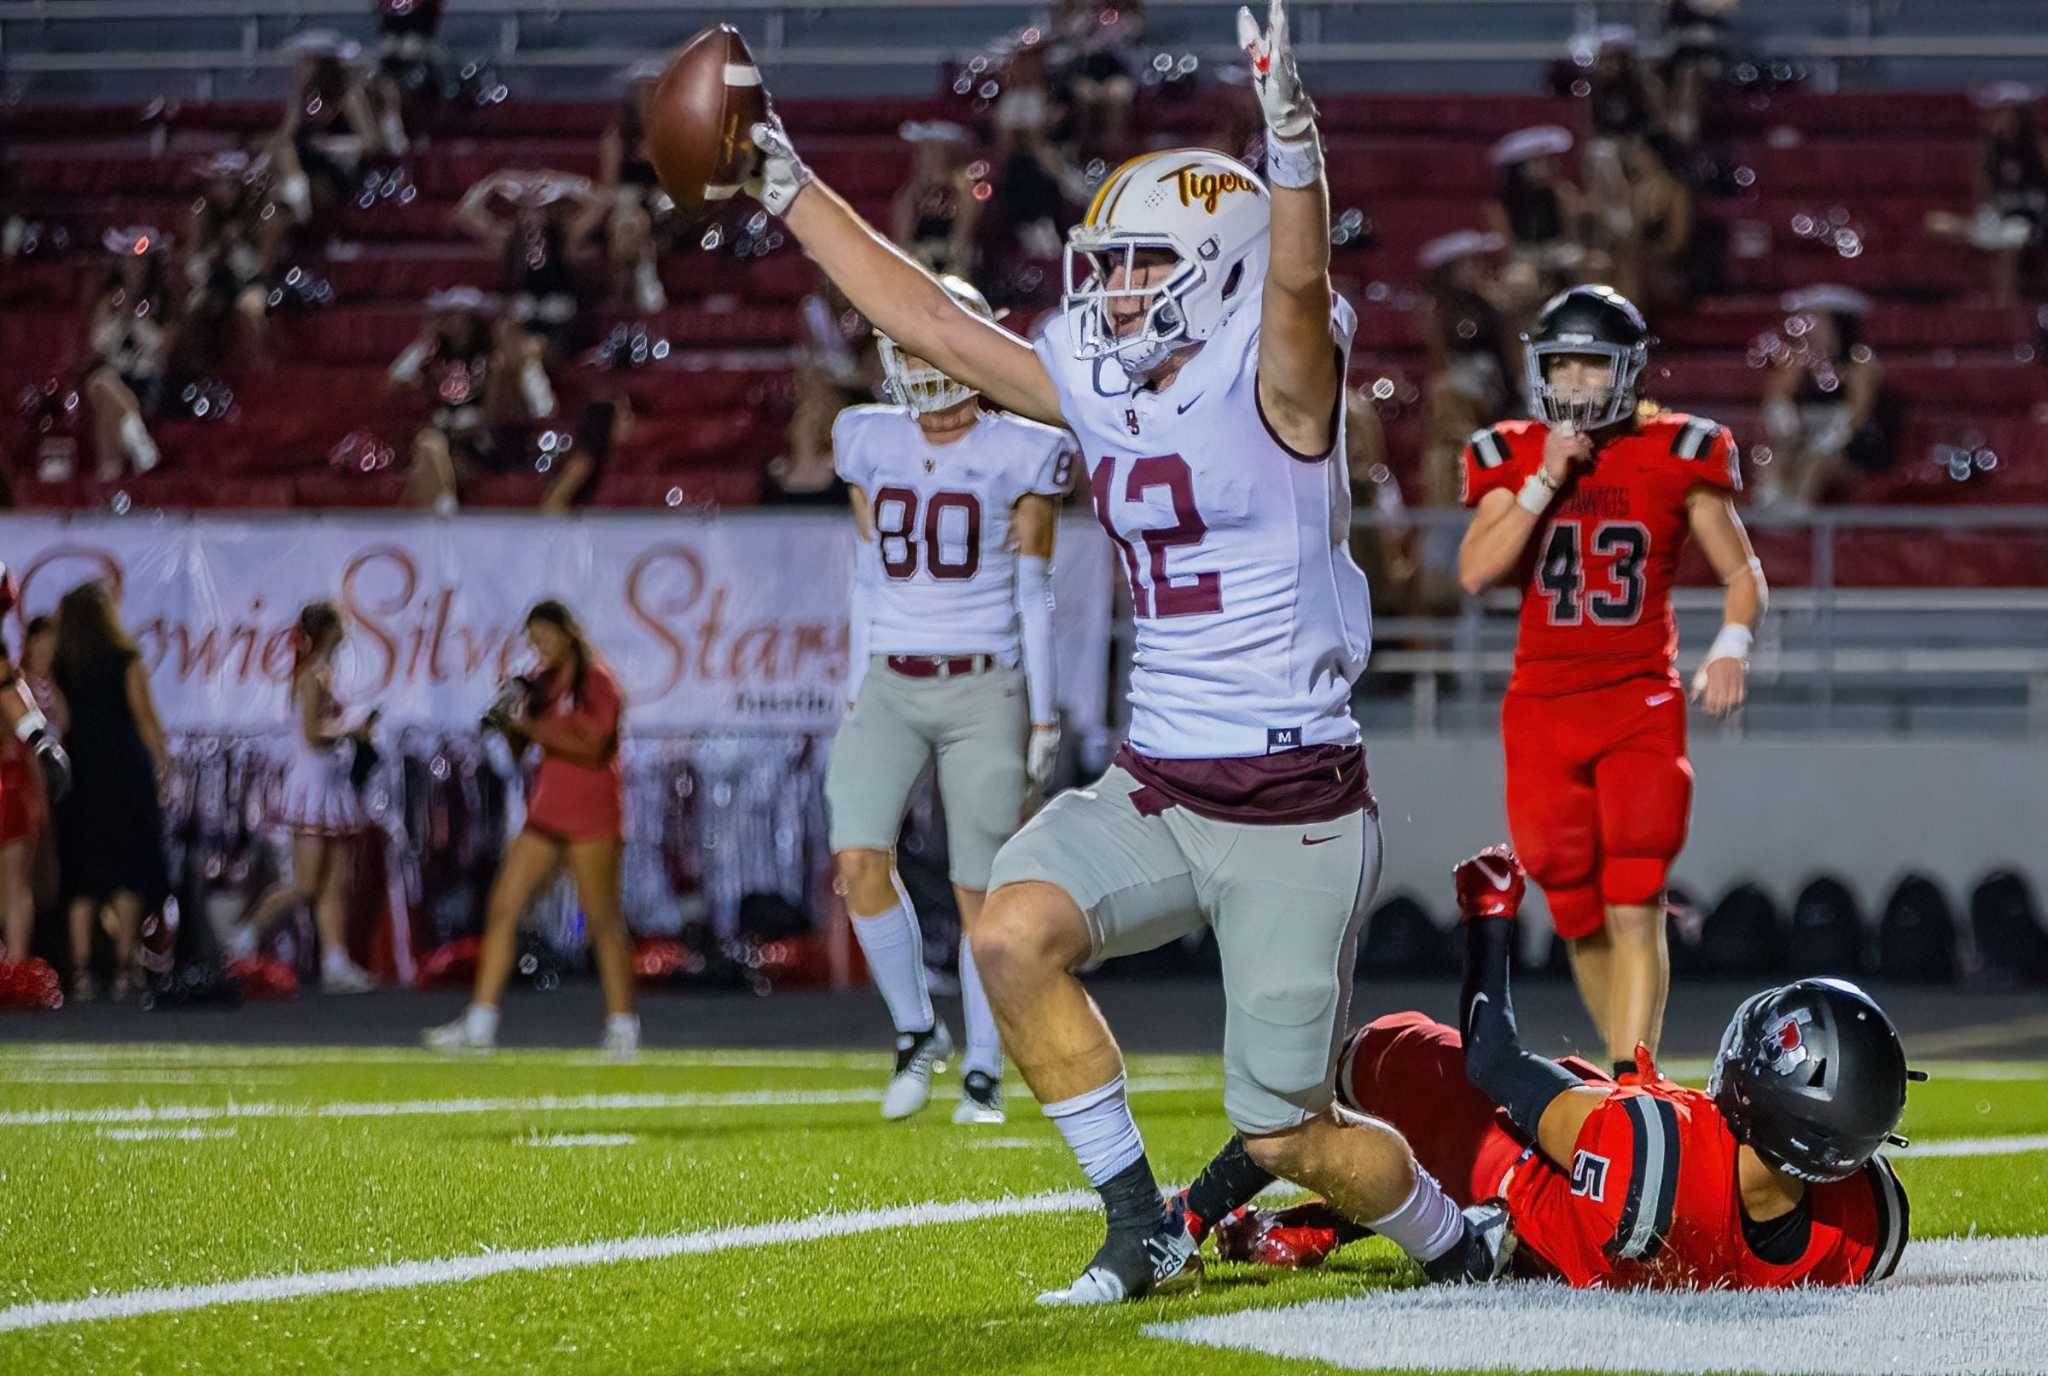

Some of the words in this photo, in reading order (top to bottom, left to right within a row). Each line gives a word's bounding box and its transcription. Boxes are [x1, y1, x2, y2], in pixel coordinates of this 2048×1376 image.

[873, 486, 984, 582] 80
[1090, 452, 1224, 619] 12
[1535, 520, 1651, 626] 43
[1278, 731, 1292, 743] M
[1570, 1149, 1610, 1203] 5
